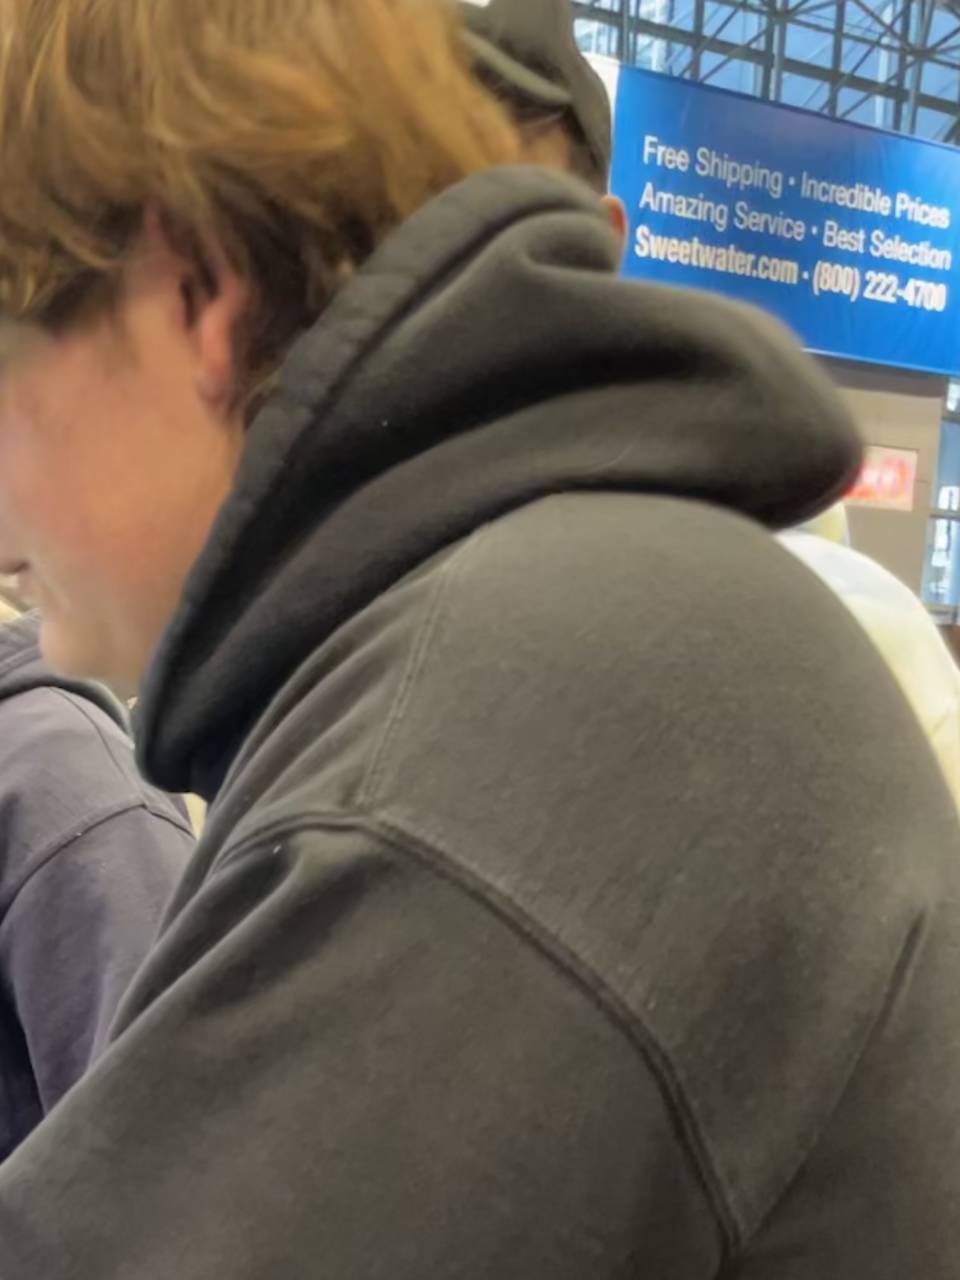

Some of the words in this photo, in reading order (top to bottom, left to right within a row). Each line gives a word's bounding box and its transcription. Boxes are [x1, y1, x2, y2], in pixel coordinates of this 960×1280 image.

[638, 181, 729, 232] Amazing
[733, 200, 806, 242] Service
[822, 219, 866, 254] Best
[869, 228, 953, 271] Selection
[643, 134, 690, 172] Free
[695, 146, 784, 199] Shipping
[800, 170, 892, 217] Incredible
[895, 191, 951, 230] Prices
[634, 223, 800, 285] Sweetwater.com
[812, 260, 861, 303] (800)
